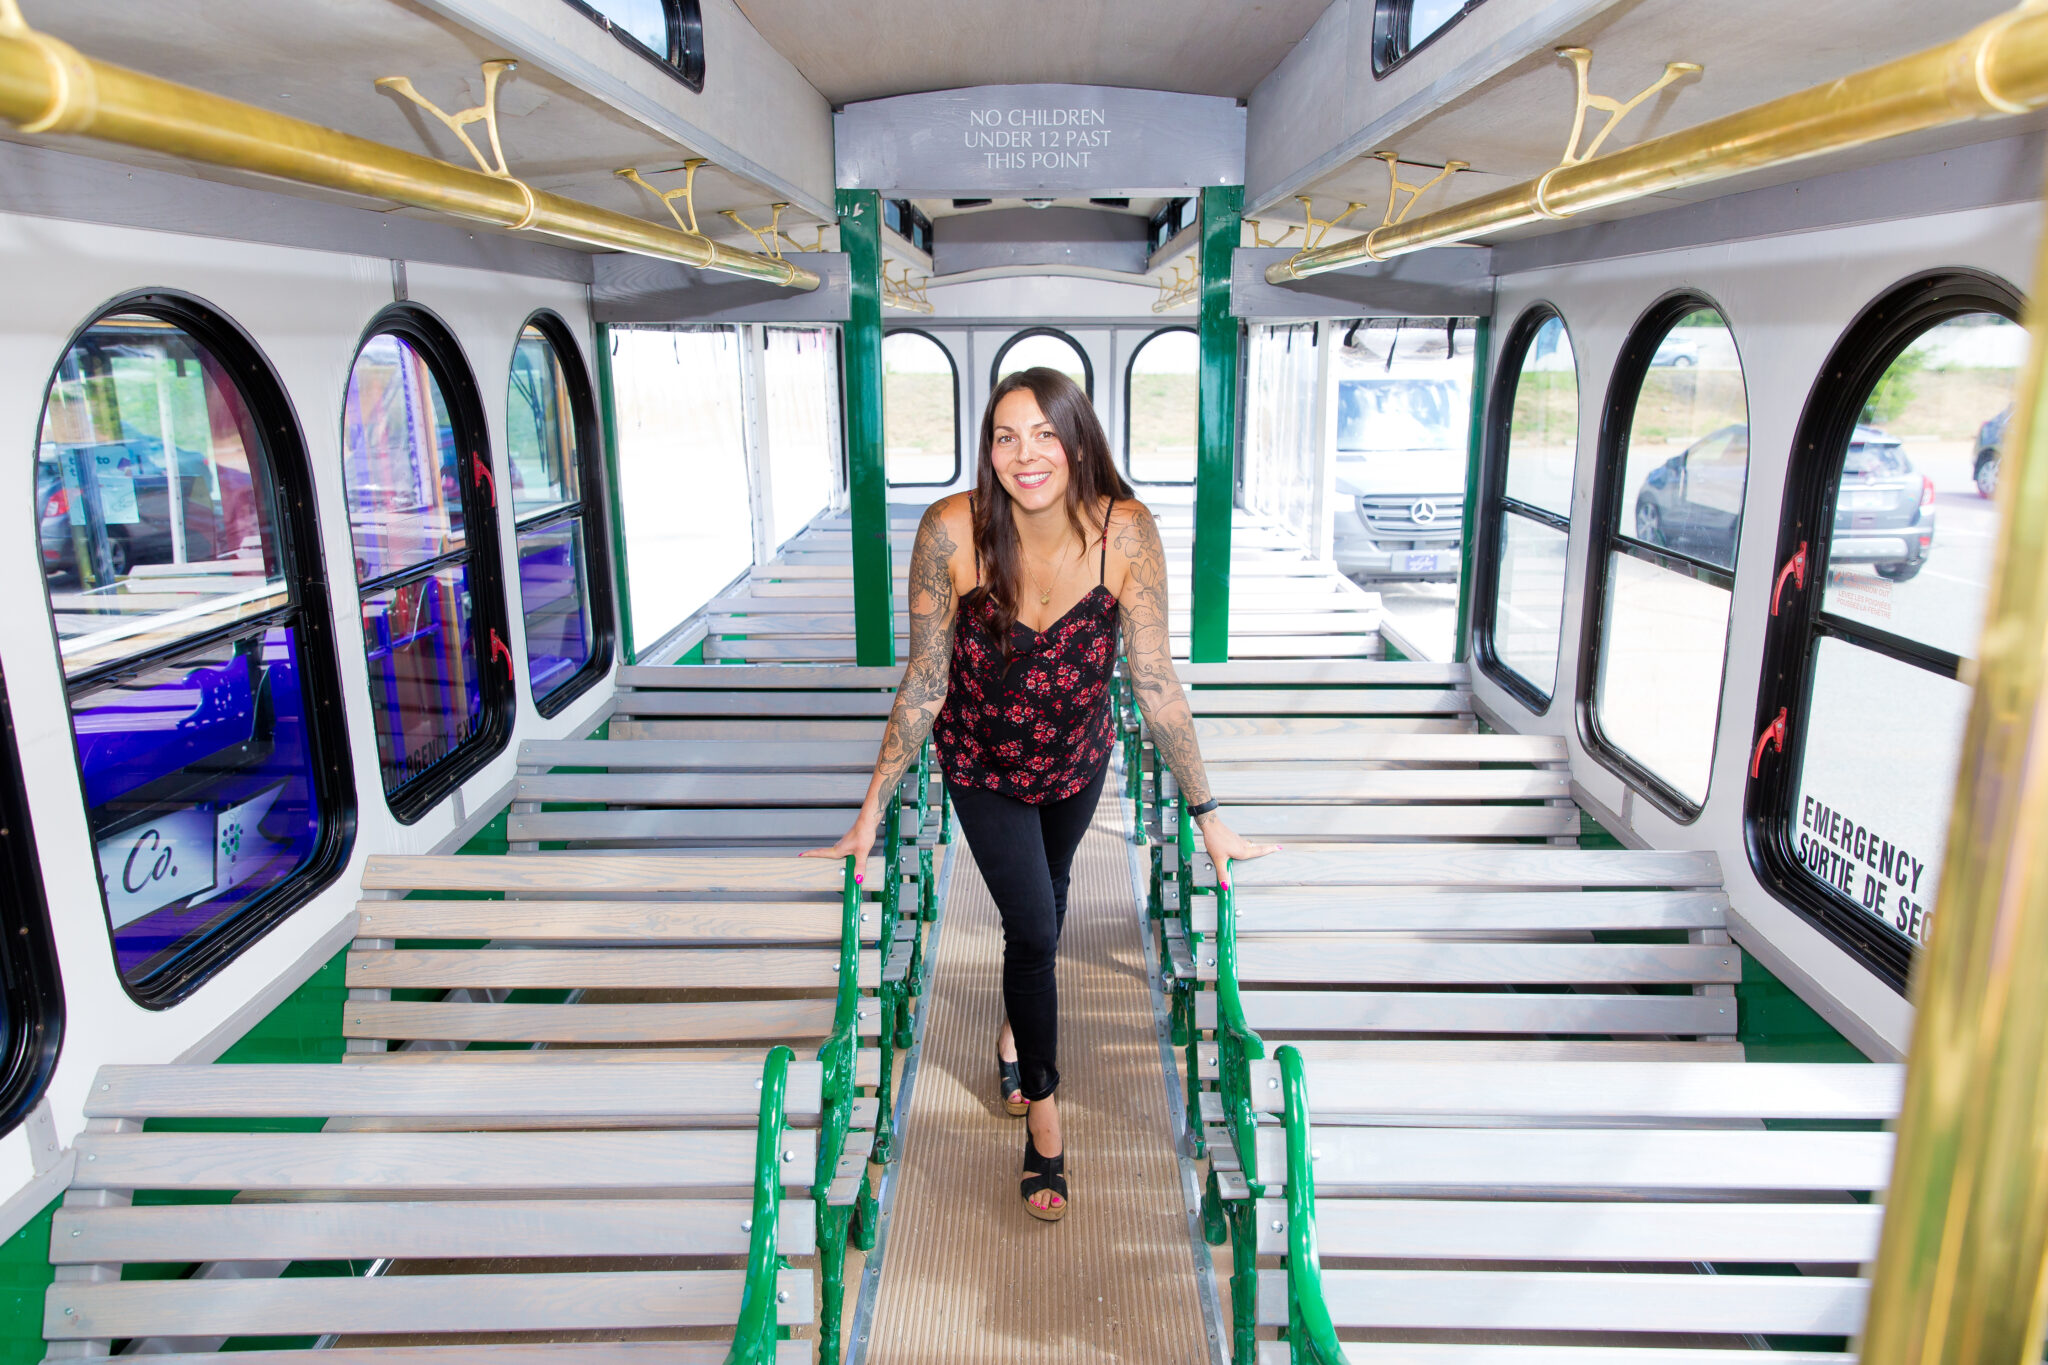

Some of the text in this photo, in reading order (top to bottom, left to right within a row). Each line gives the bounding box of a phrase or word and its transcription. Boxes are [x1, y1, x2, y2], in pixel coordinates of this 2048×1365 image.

[970, 108, 1105, 126] NO CHILDREN
[964, 130, 1111, 148] UNDER 12 PAST
[984, 151, 1092, 169] THIS POINT
[457, 713, 479, 745] EXIT
[1802, 795, 1925, 894] EMERGENCY
[122, 829, 178, 893] Co.
[1799, 832, 1855, 896] SORTIE
[1863, 873, 1888, 918] DE
